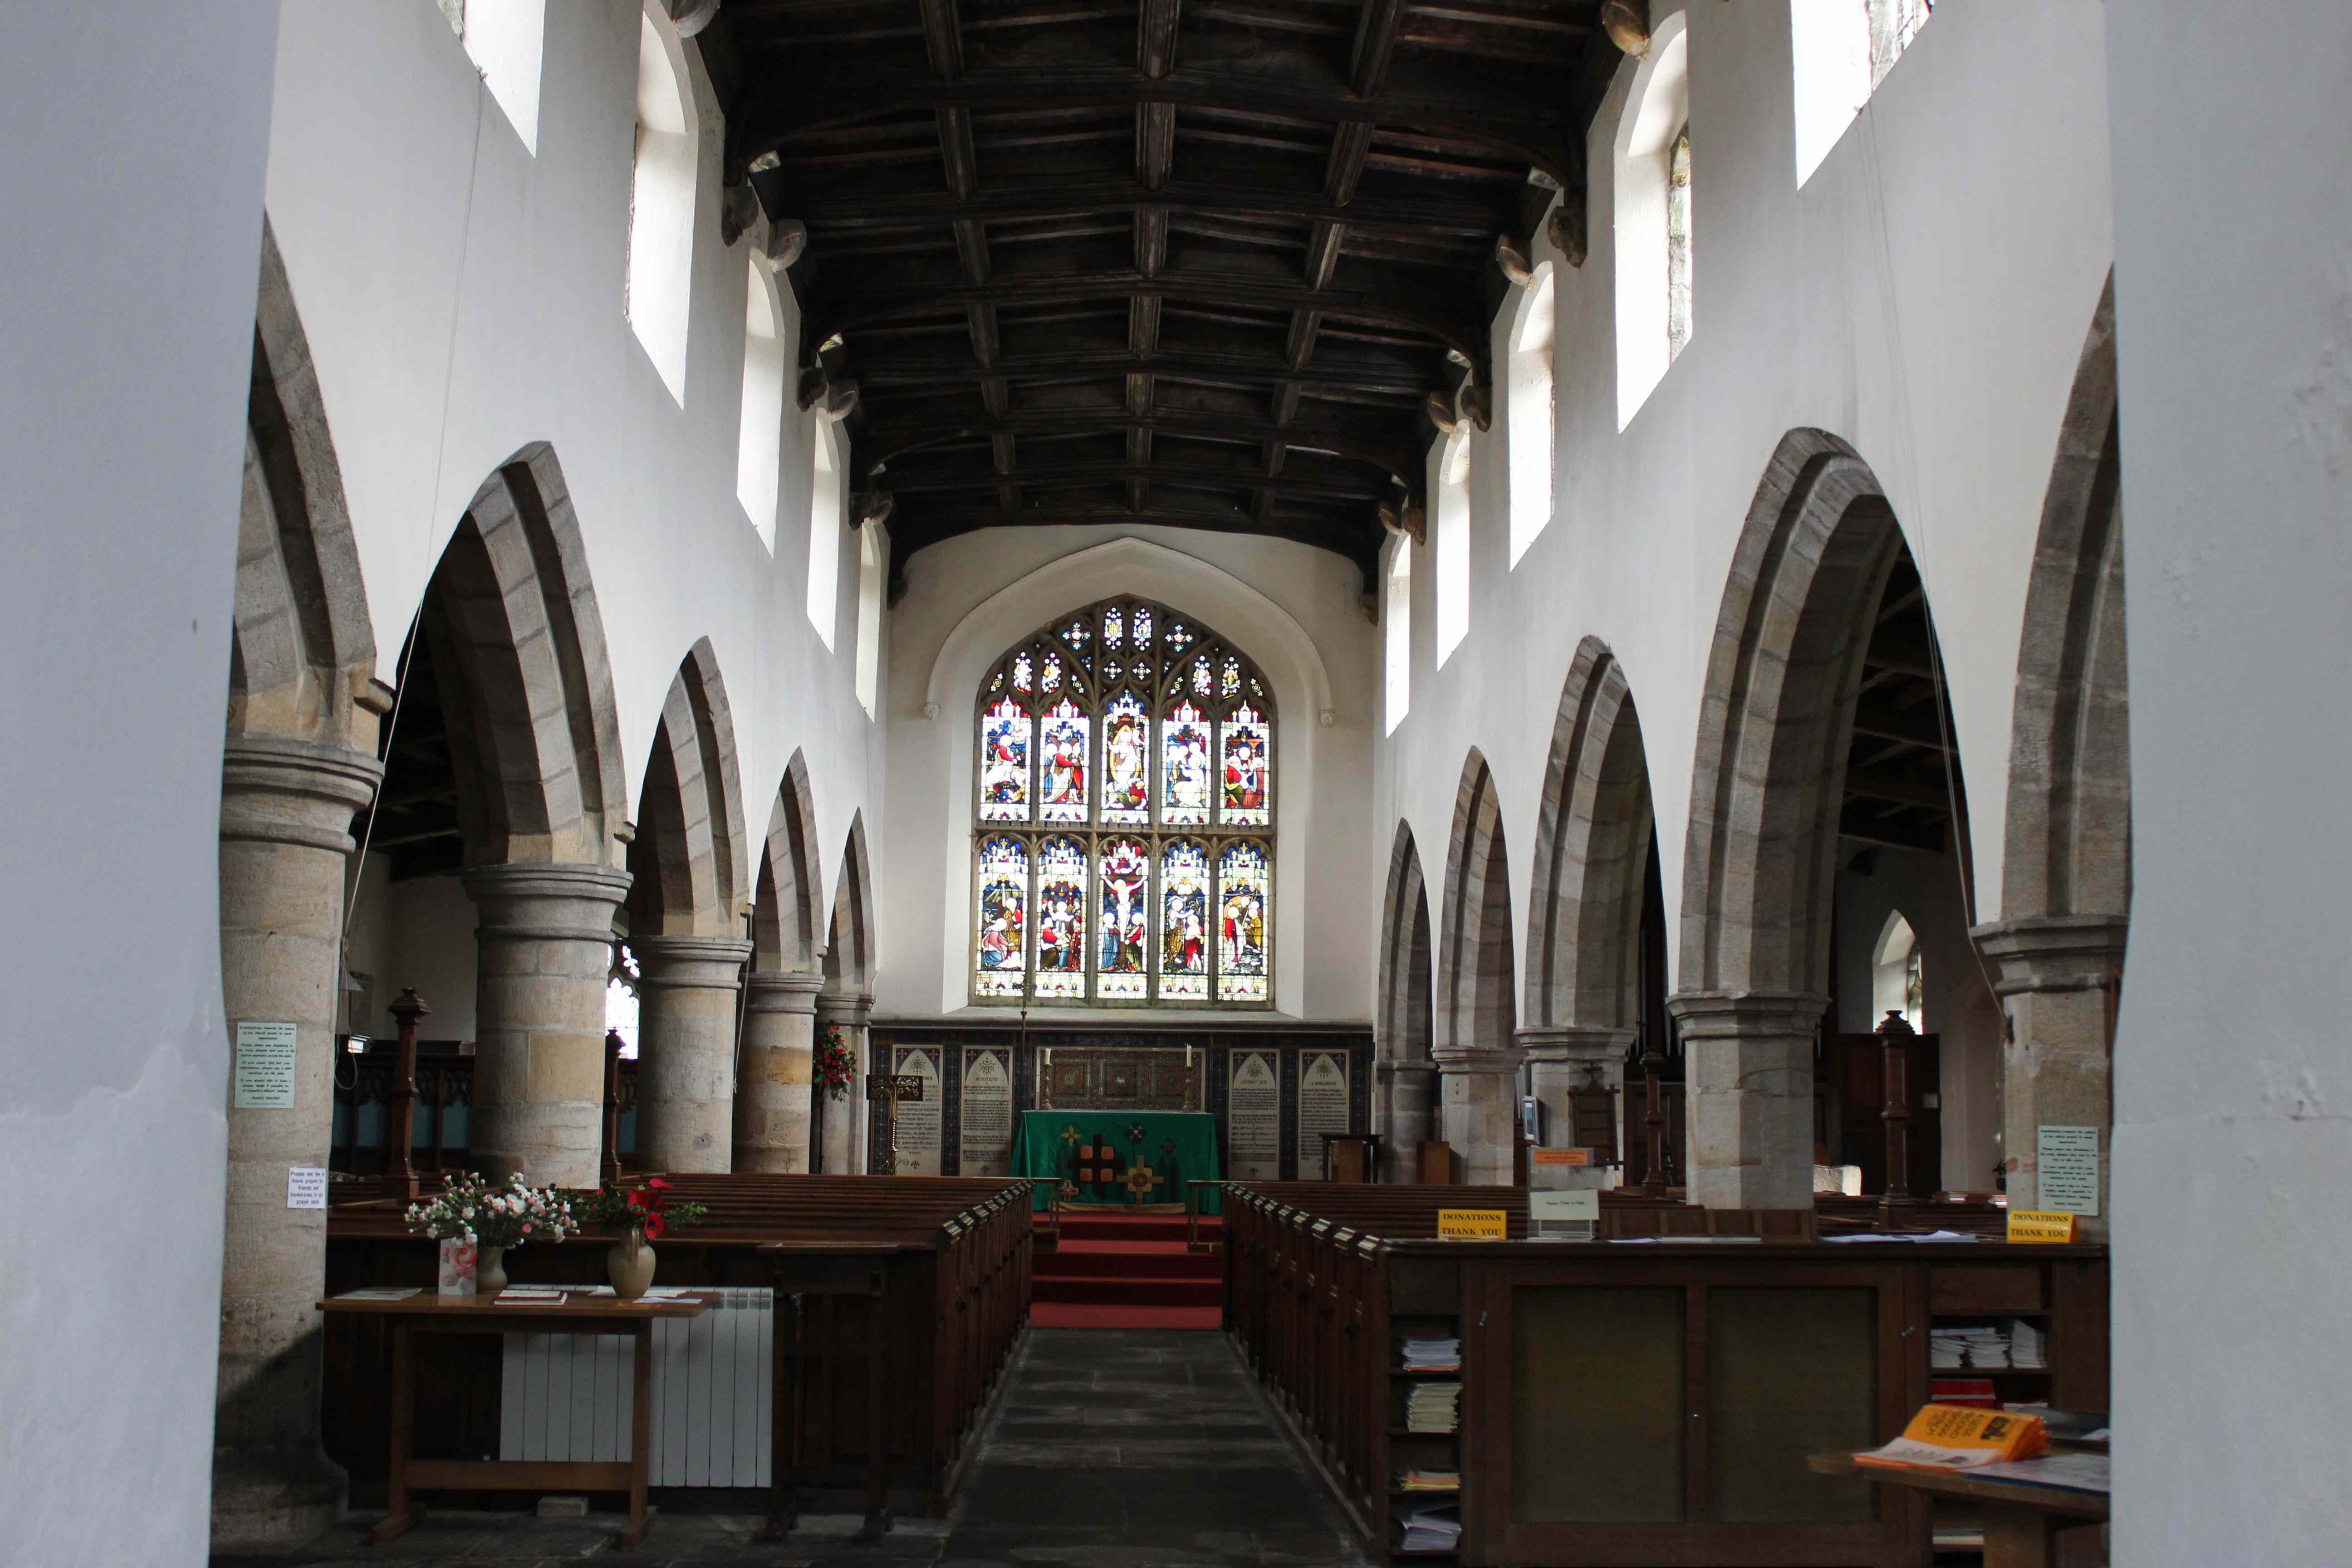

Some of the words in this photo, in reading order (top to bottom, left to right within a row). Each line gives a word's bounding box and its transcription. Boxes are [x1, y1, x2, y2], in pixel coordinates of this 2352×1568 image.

[2014, 1213, 2069, 1222] DONATIONS
[2011, 1228, 2043, 1237] THANK
[2047, 1229, 2067, 1238] YOU
